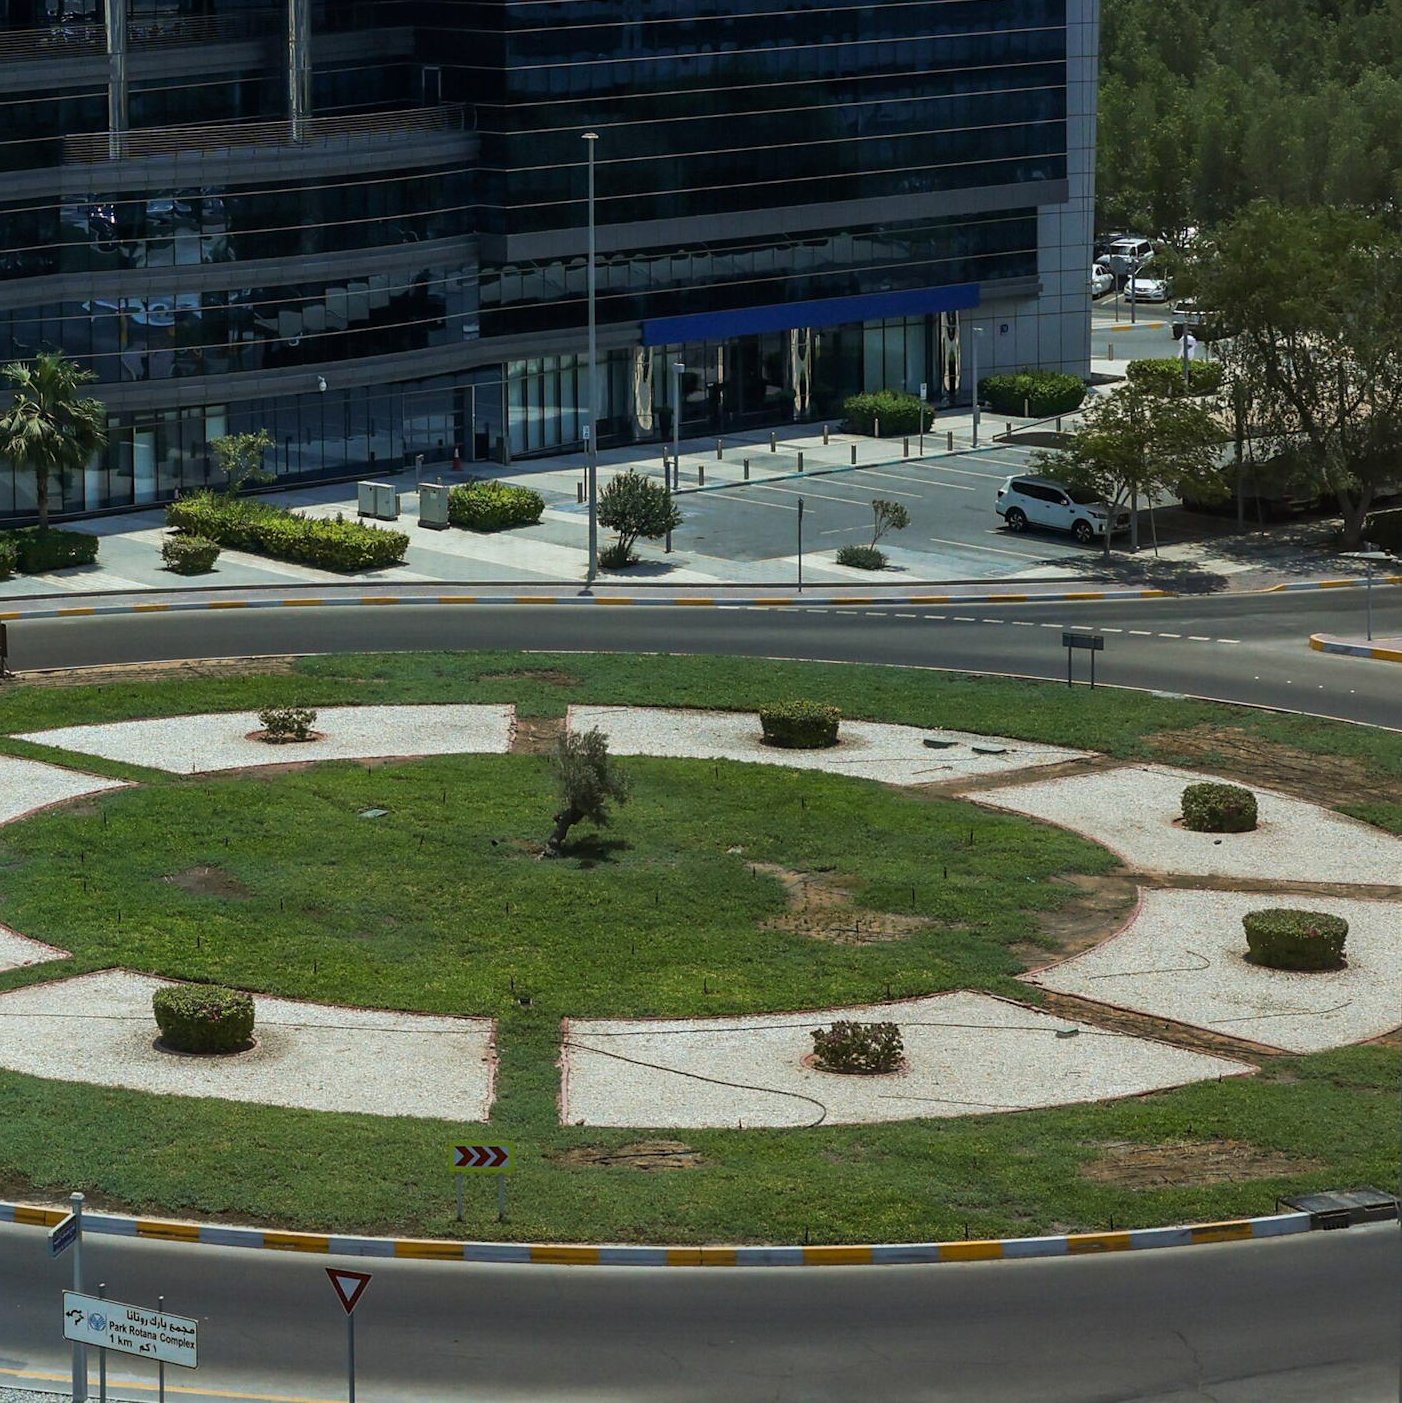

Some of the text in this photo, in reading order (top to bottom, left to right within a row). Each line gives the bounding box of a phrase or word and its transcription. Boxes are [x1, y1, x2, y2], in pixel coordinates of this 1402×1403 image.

[109, 1321, 195, 1349] Park Rotana Complex
[170, 1324, 195, 1335] مجمع
[110, 1333, 132, 1347] 1 km
[139, 1343, 150, 1353] كم
